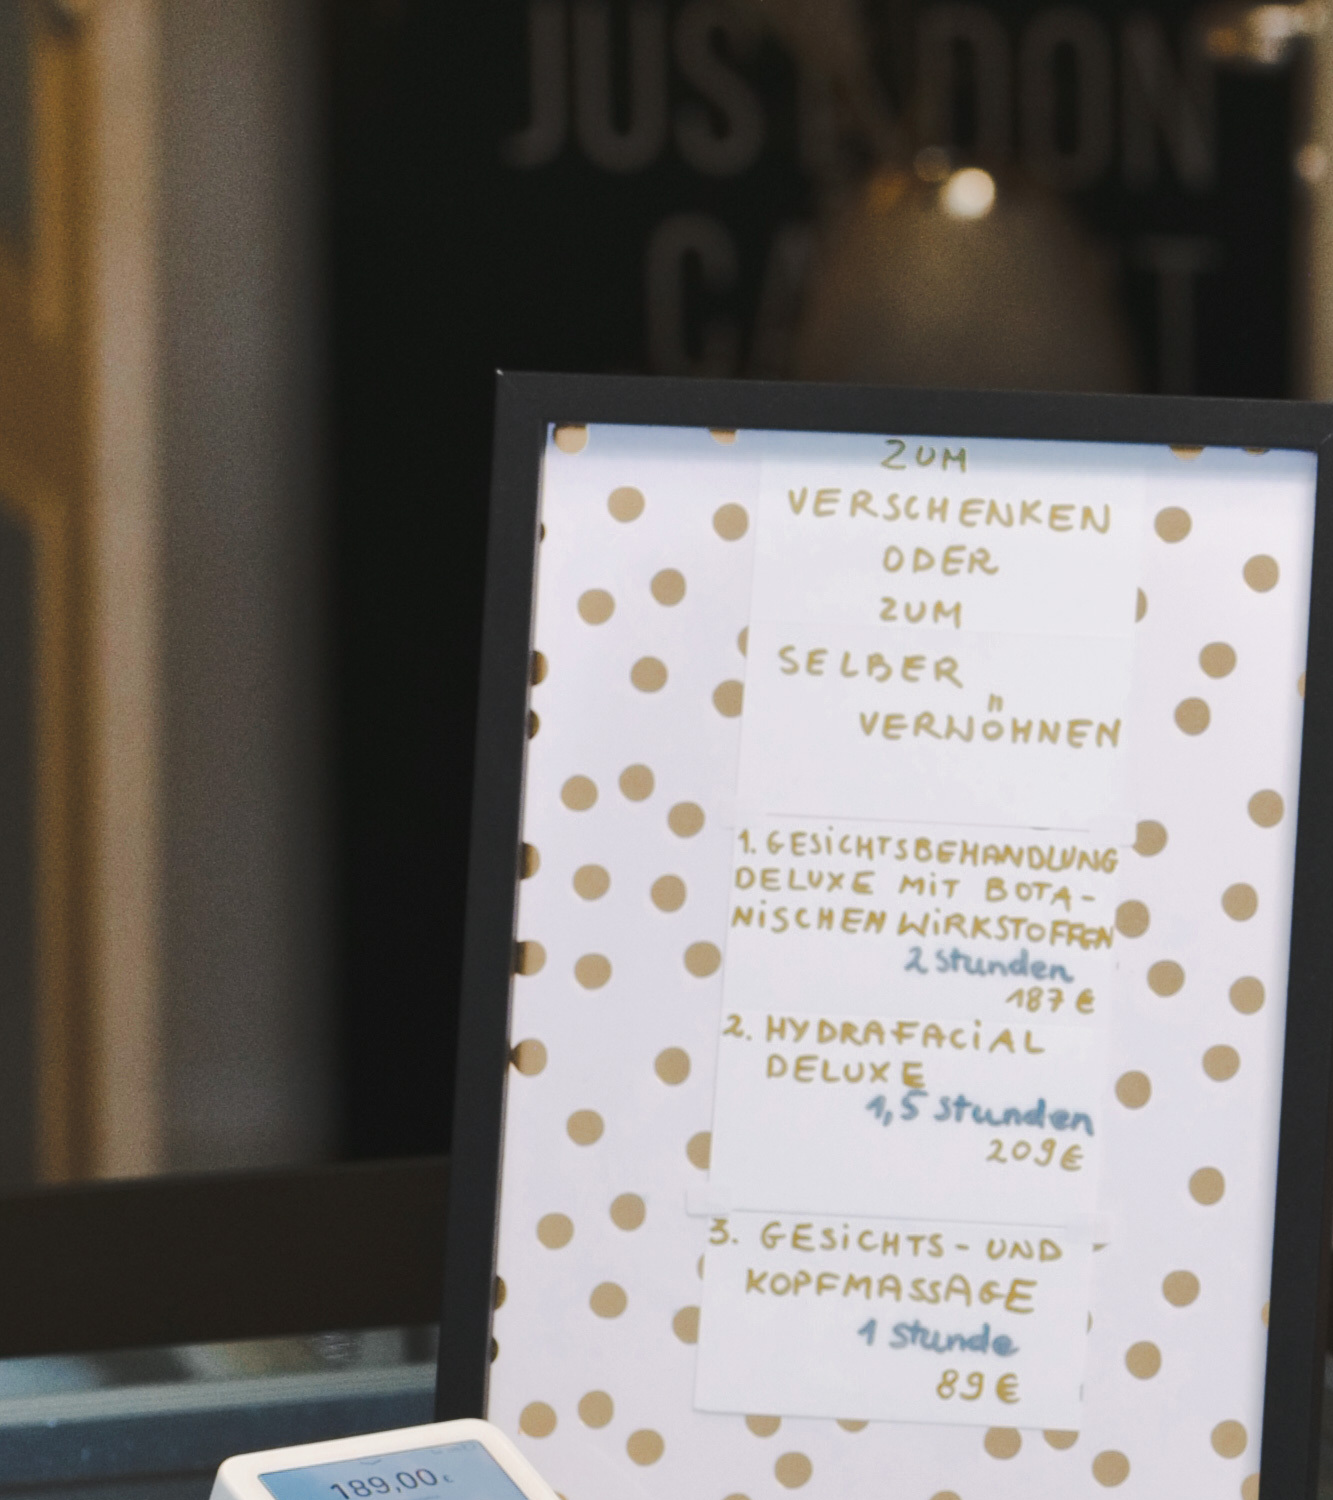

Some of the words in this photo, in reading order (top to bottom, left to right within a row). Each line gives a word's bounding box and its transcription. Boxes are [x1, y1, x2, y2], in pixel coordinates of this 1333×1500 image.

[881, 438, 967, 473] ZUM
[788, 487, 1111, 533] VERSCHENKEN
[883, 545, 999, 575] ODER
[880, 597, 962, 629] ZUM
[778, 645, 963, 688] SELBER
[860, 693, 1121, 748] VERWÖHNEN
[737, 829, 757, 854] 1.
[735, 866, 875, 895] DELUXE
[904, 946, 929, 975] 2
[722, 1013, 752, 1041] 2.
[766, 1054, 926, 1090] DELUXE
[865, 1088, 929, 1127] 1,5
[709, 1217, 739, 1246] 3.
[986, 1238, 1063, 1262] UND
[746, 1268, 1038, 1314] KOPFMASSAGE
[857, 1318, 877, 1347] 1
[331, 1468, 438, 1500] 189,00
